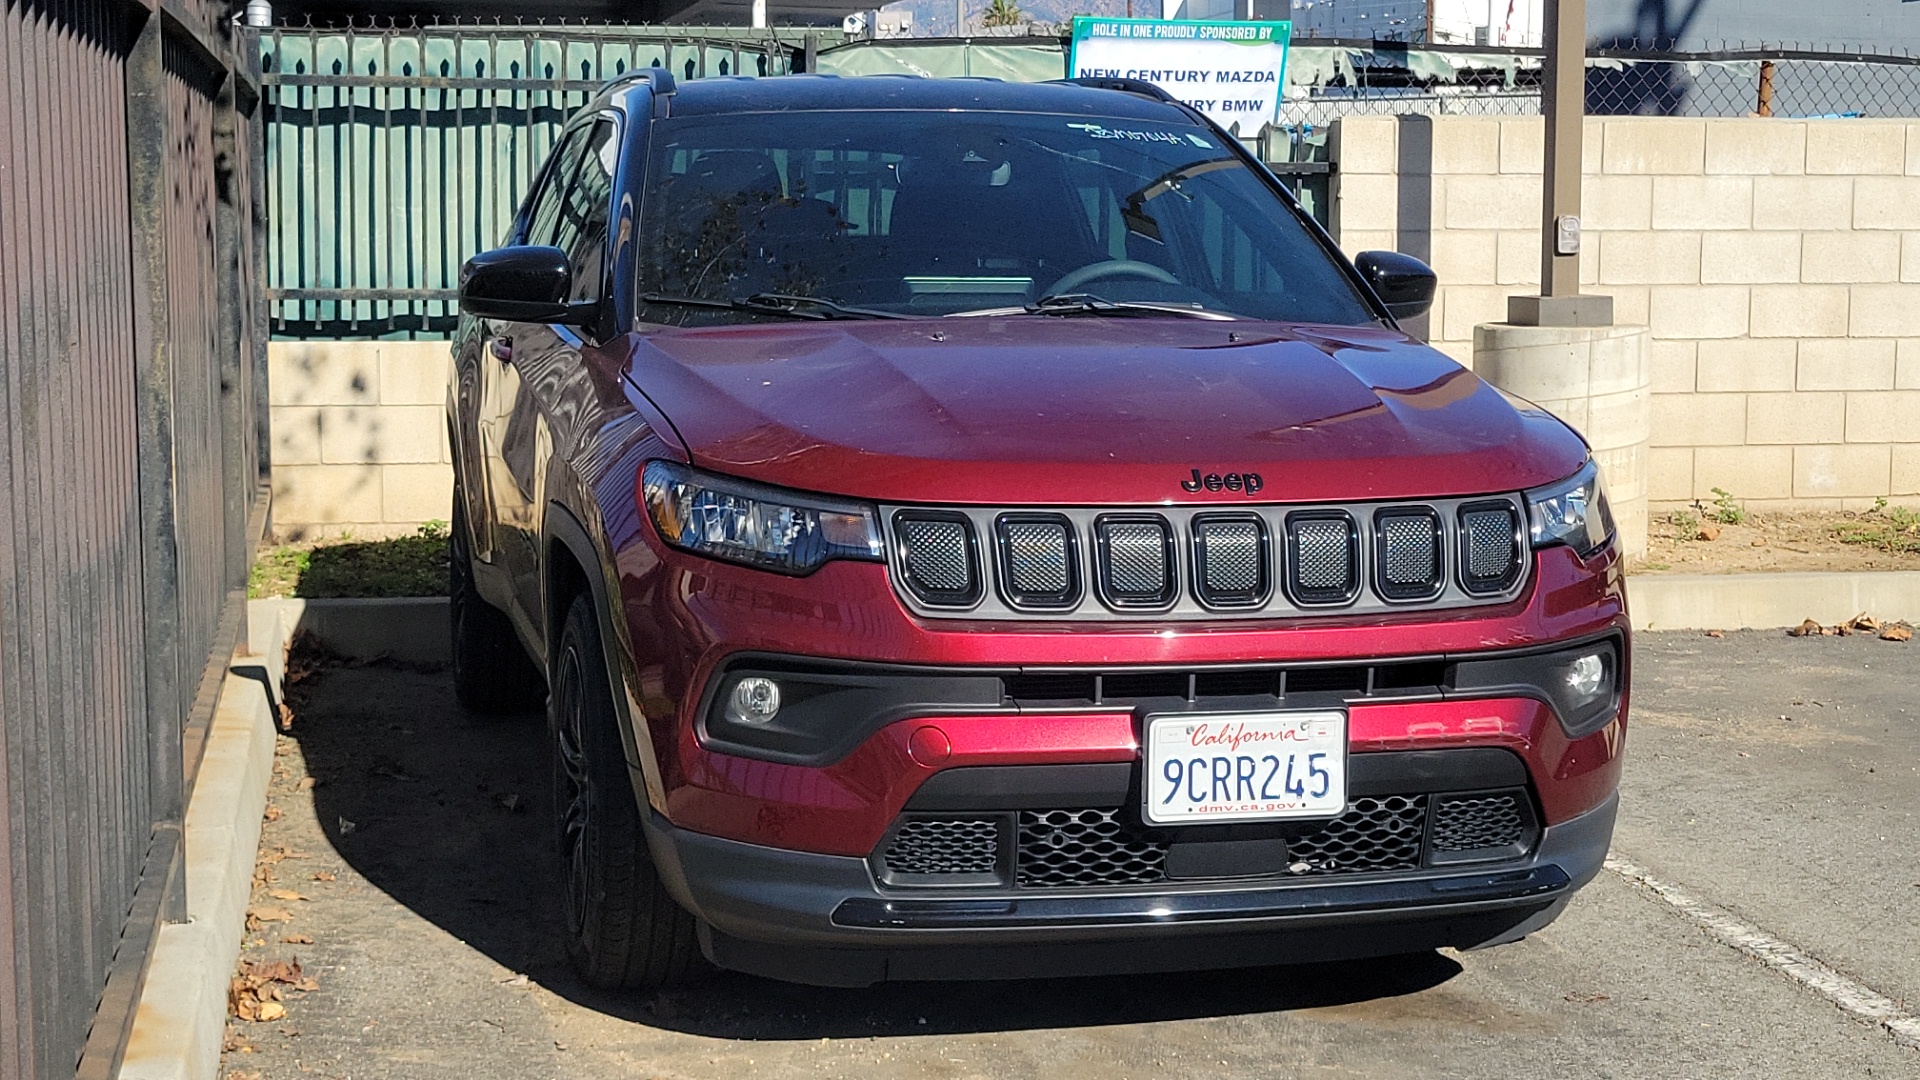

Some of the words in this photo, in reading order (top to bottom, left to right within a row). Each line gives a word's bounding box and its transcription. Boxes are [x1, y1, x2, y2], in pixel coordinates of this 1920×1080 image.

[1092, 23, 1119, 37] HOLE
[1120, 24, 1132, 38] IN
[1133, 24, 1152, 38] ONE
[1154, 25, 1197, 39] PROUDLY
[1200, 26, 1256, 40] SPONSORED
[1258, 27, 1273, 40] BY
[1080, 68, 1120, 79] NEW
[1126, 69, 1210, 82] CENTURY
[1215, 71, 1276, 83] MAZDA
[1222, 100, 1264, 112] BMW
[1181, 469, 1263, 496] Jeep
[1191, 722, 1309, 752] California
[1162, 753, 1330, 805] 9CRR245
[1199, 802, 1296, 813] dmv.ca.gov
